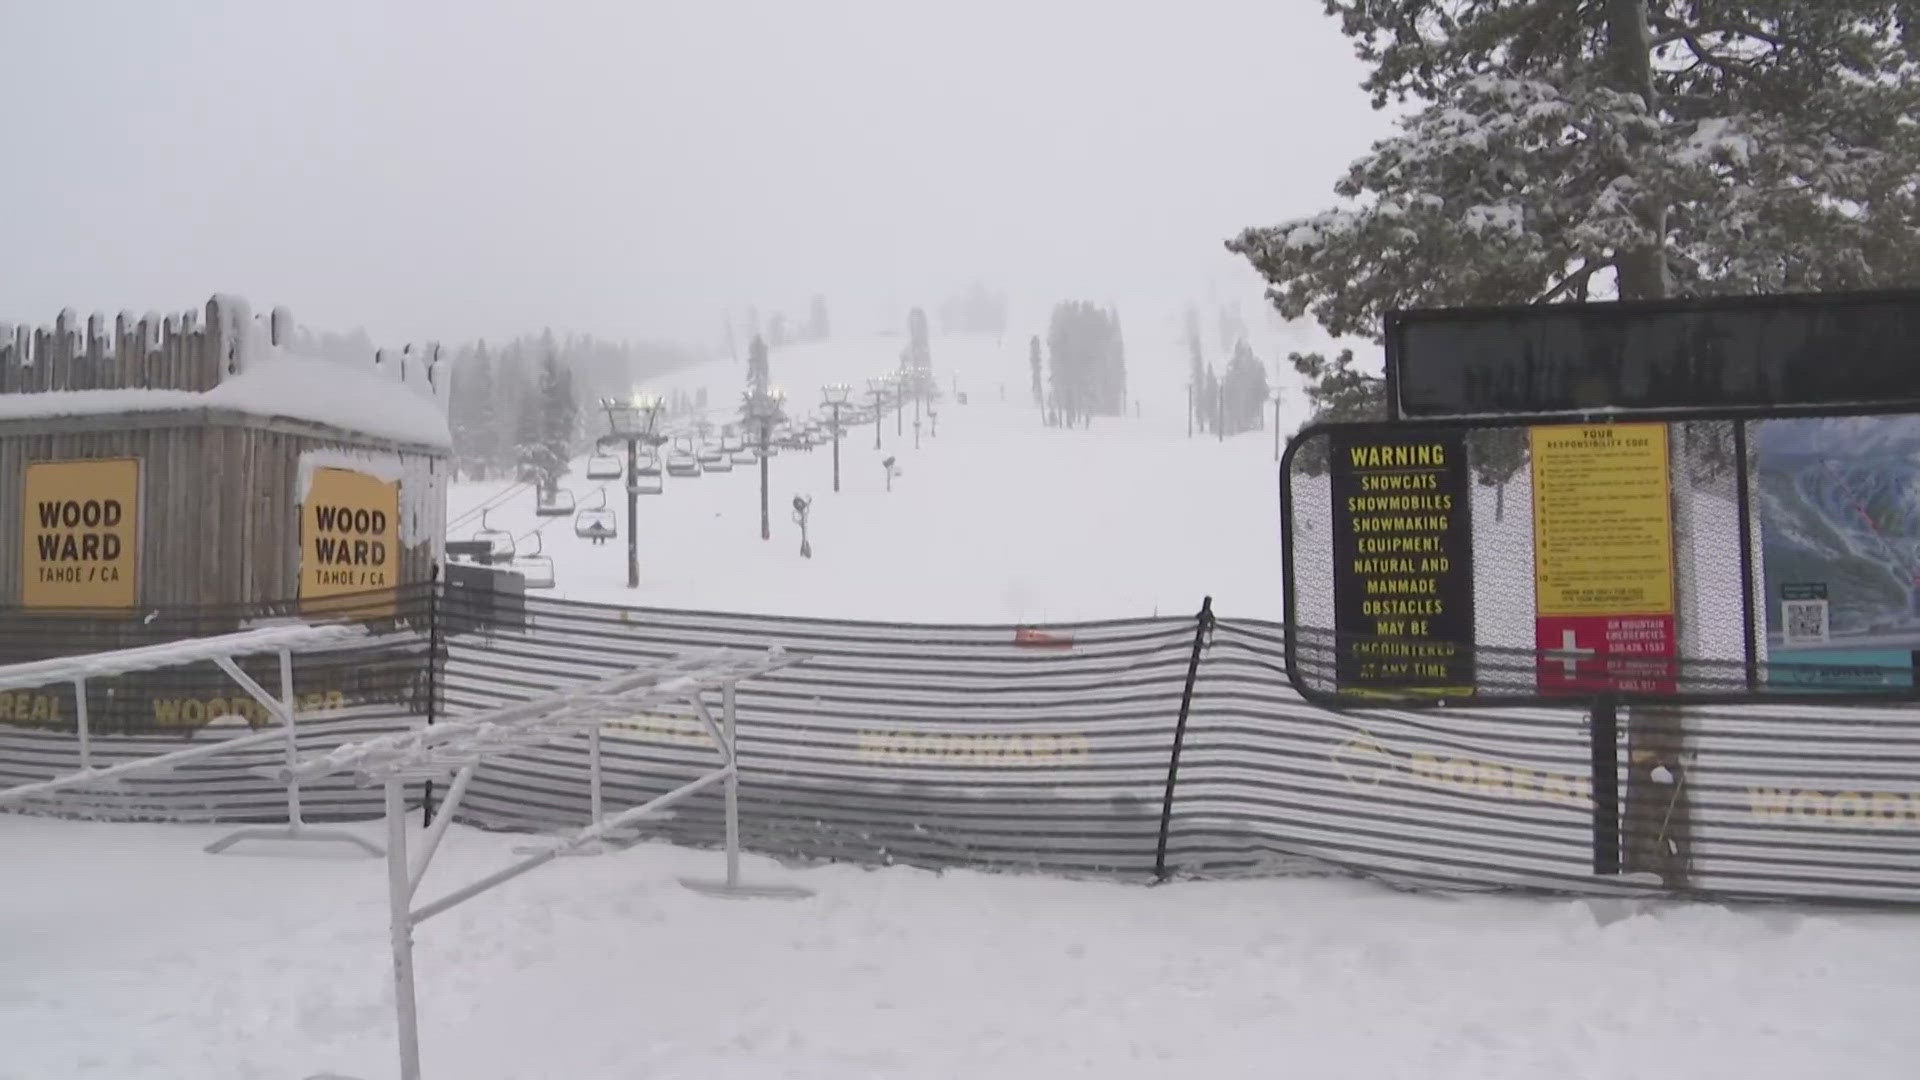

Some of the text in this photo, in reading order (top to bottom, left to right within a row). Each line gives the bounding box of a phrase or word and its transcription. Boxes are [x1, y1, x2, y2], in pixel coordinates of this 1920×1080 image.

[1583, 429, 1613, 438] YOUR
[1350, 444, 1445, 467] WARNING
[1361, 474, 1437, 491] SNOWCATS
[1348, 495, 1452, 512] SNOWMOBILES
[39, 499, 122, 528] WOOD
[316, 505, 387, 535] WOOD
[1352, 515, 1448, 533] SNOWMAKING
[38, 533, 121, 562] WARD
[315, 537, 386, 566] WARD
[39, 566, 81, 582] TAHOE
[101, 566, 119, 582] CA
[1354, 557, 1449, 574] NATURAL AND
[316, 569, 354, 586] TAHOE
[370, 571, 384, 586] CA
[1367, 578, 1437, 594] MANMADE
[1363, 599, 1443, 615] OBSTACLES
[1377, 620, 1429, 636] MAY BE
[1352, 641, 1455, 658] ENCOUNTERED
[1415, 663, 1448, 678] TIME
[1748, 786, 1920, 828] WOOD
